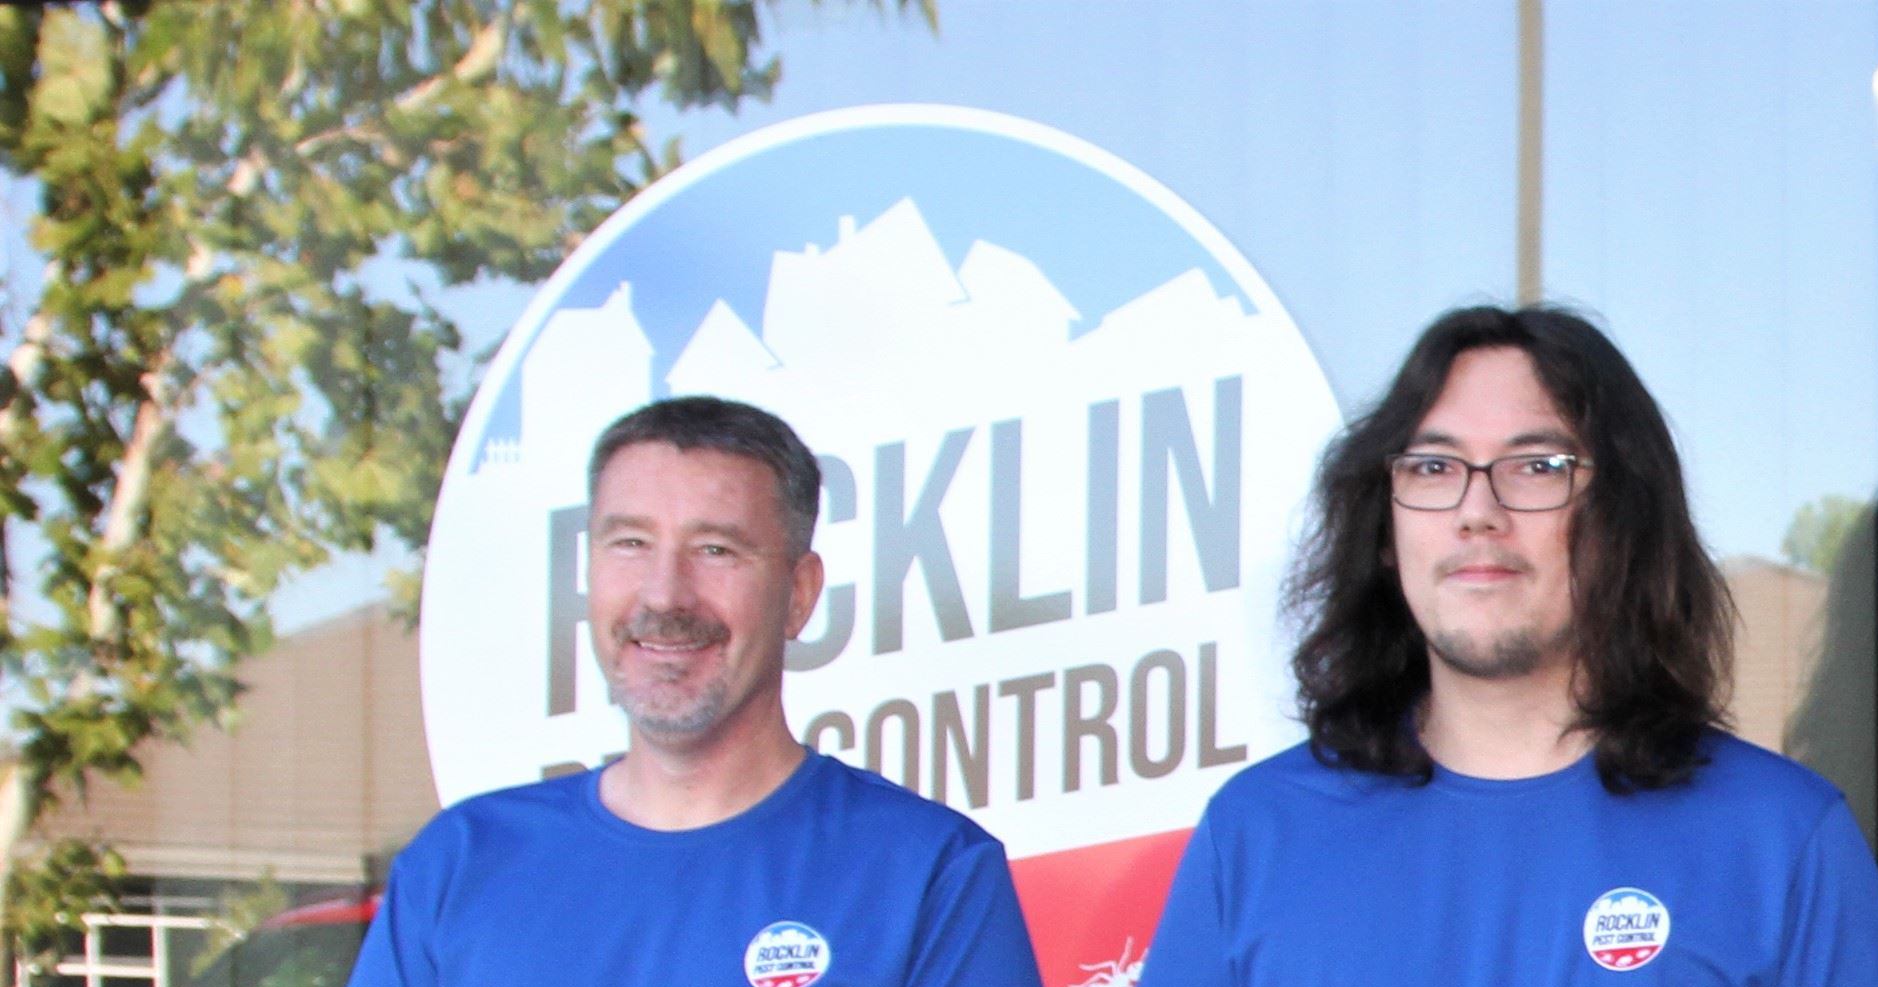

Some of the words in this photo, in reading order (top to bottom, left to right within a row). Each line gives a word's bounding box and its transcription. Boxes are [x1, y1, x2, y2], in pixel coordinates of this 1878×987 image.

[545, 374, 1243, 717] CKLIN
[1596, 913, 1660, 932] ROCKLIN
[1593, 935, 1614, 945] PEST
[1617, 932, 1655, 943] CONTROL
[757, 944, 819, 961] ROCKLIN
[754, 964, 774, 974] PEST
[777, 961, 815, 971] CONTROL
